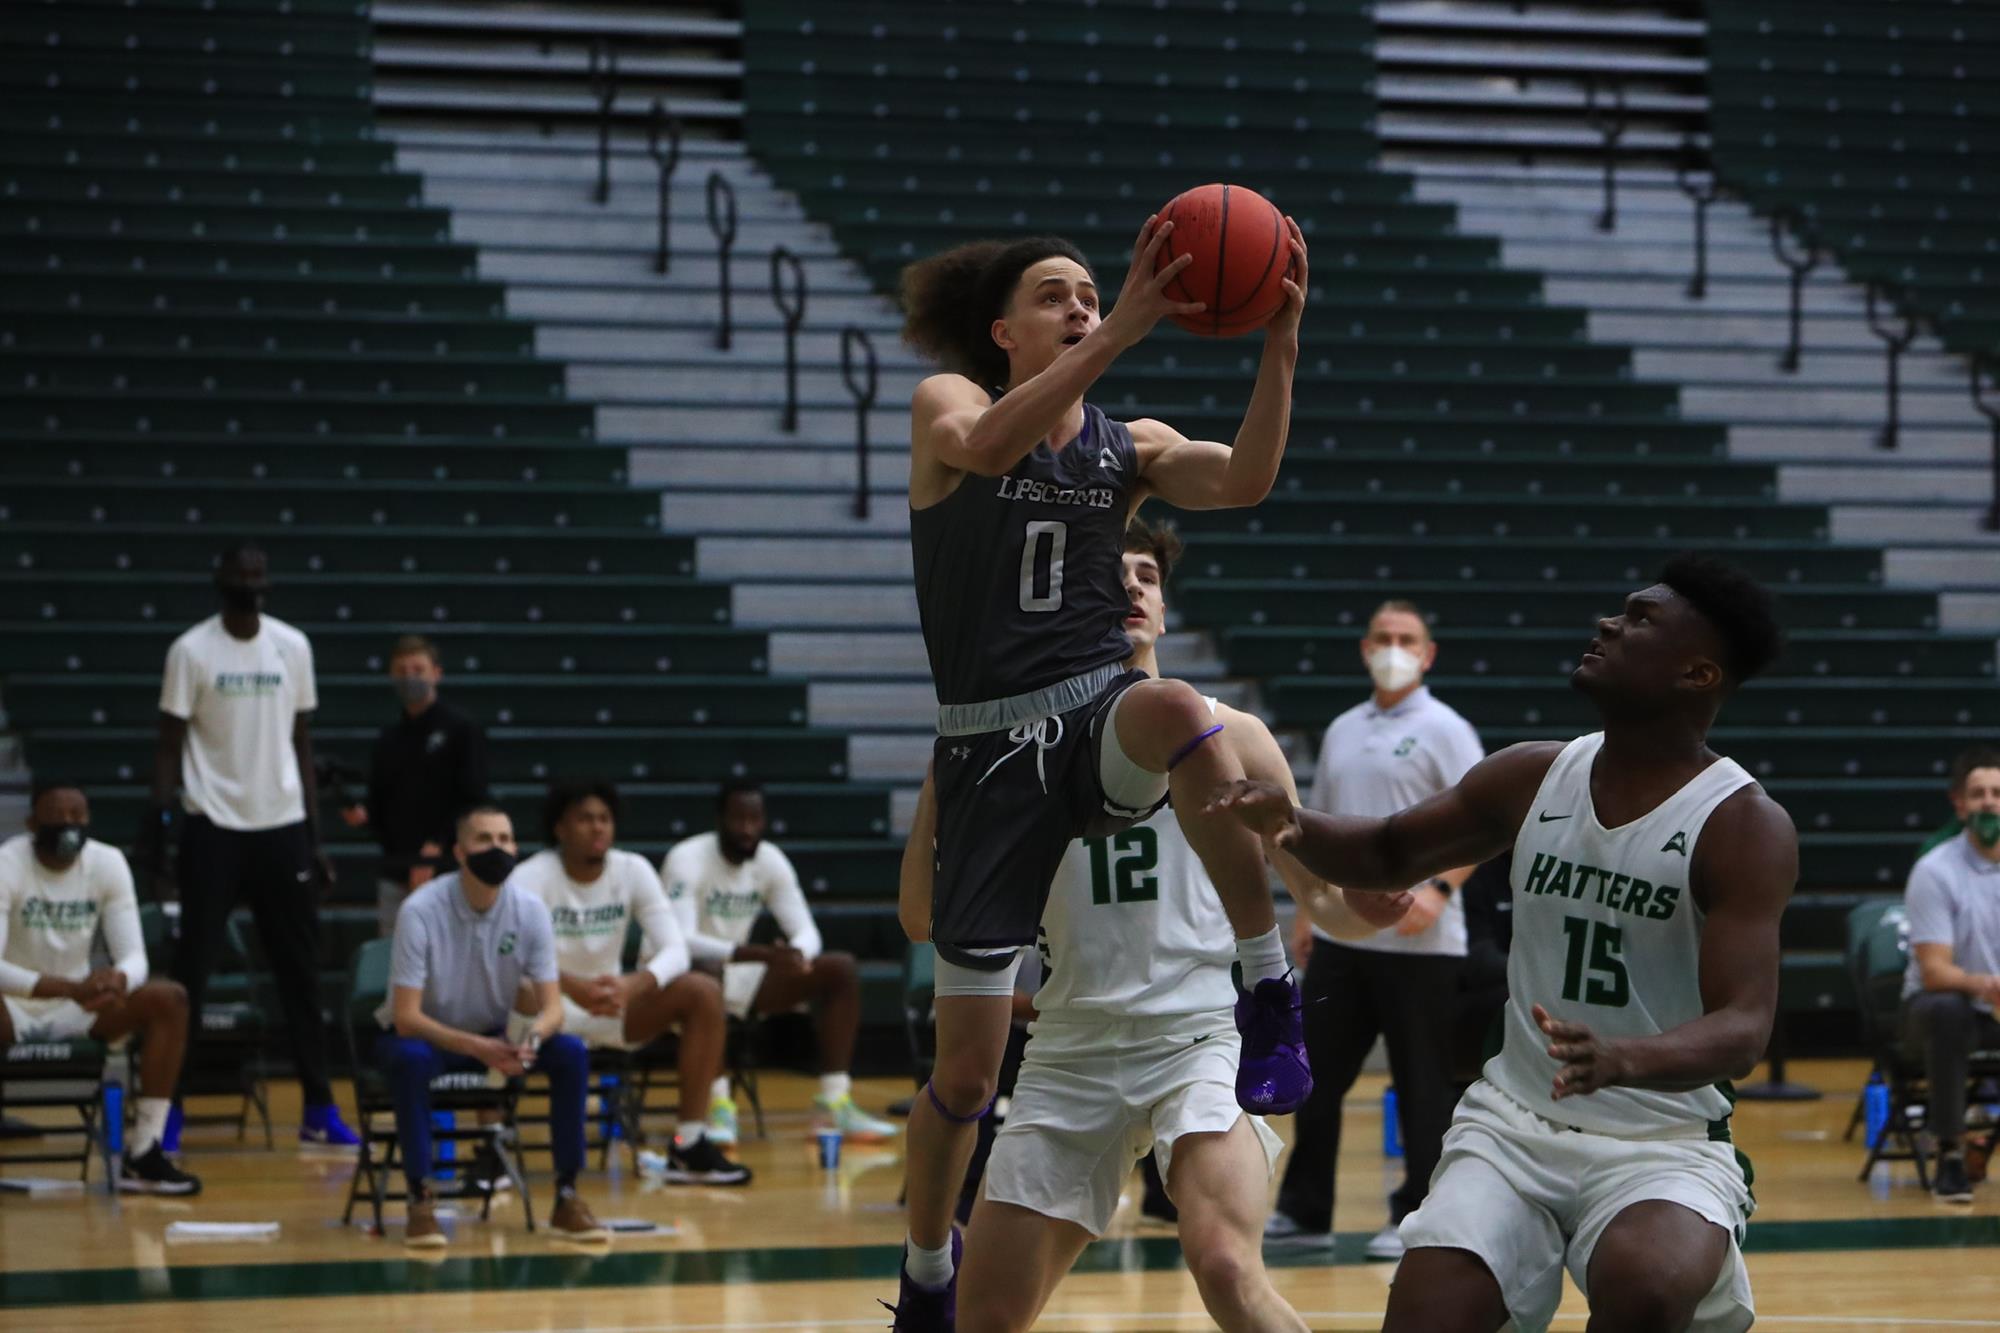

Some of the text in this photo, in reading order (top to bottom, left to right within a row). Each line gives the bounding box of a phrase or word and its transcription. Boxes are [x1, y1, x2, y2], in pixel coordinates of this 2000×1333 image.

[1019, 520, 1067, 612] 0
[1082, 826, 1158, 905] 12
[1524, 852, 1681, 920] HATTERS
[1562, 915, 1630, 1008] 15
